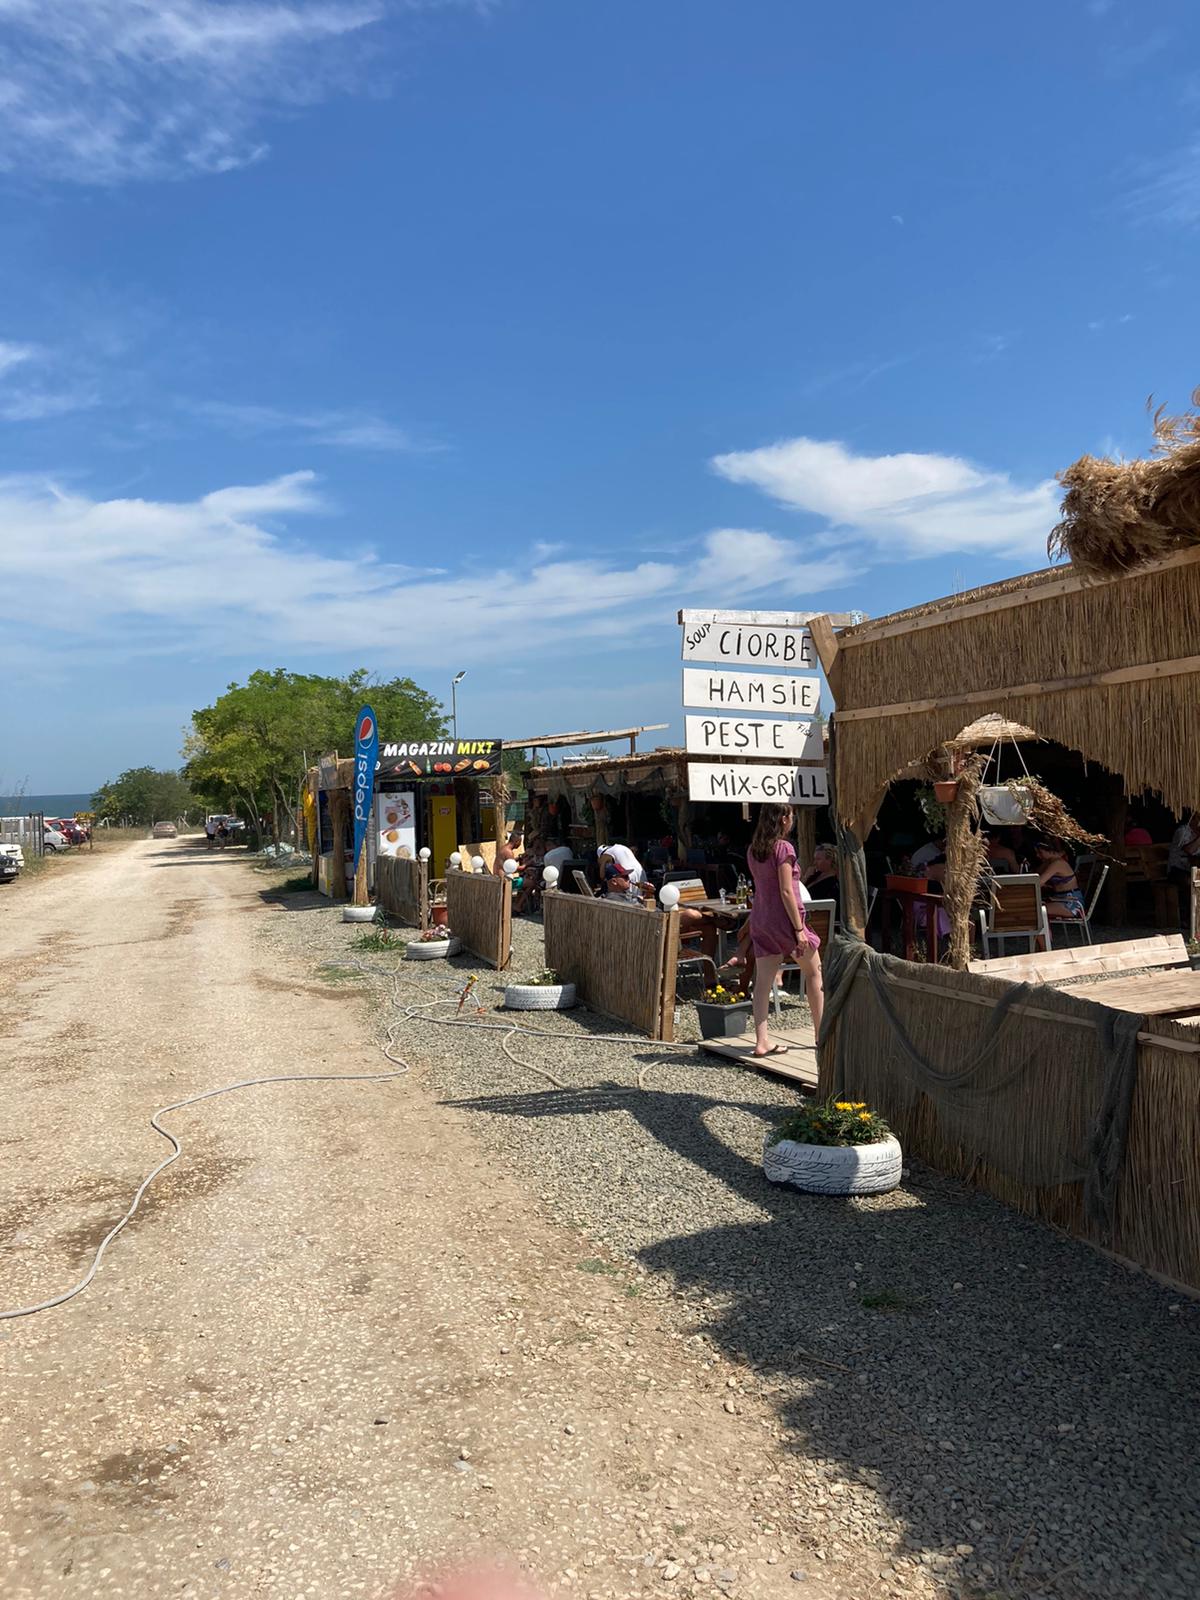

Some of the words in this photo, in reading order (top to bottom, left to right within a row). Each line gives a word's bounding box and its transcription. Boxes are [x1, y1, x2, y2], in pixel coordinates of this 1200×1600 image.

[383, 742, 455, 757] MAGAZIN
[457, 741, 495, 755] MIXT
[355, 753, 370, 821] pepsi
